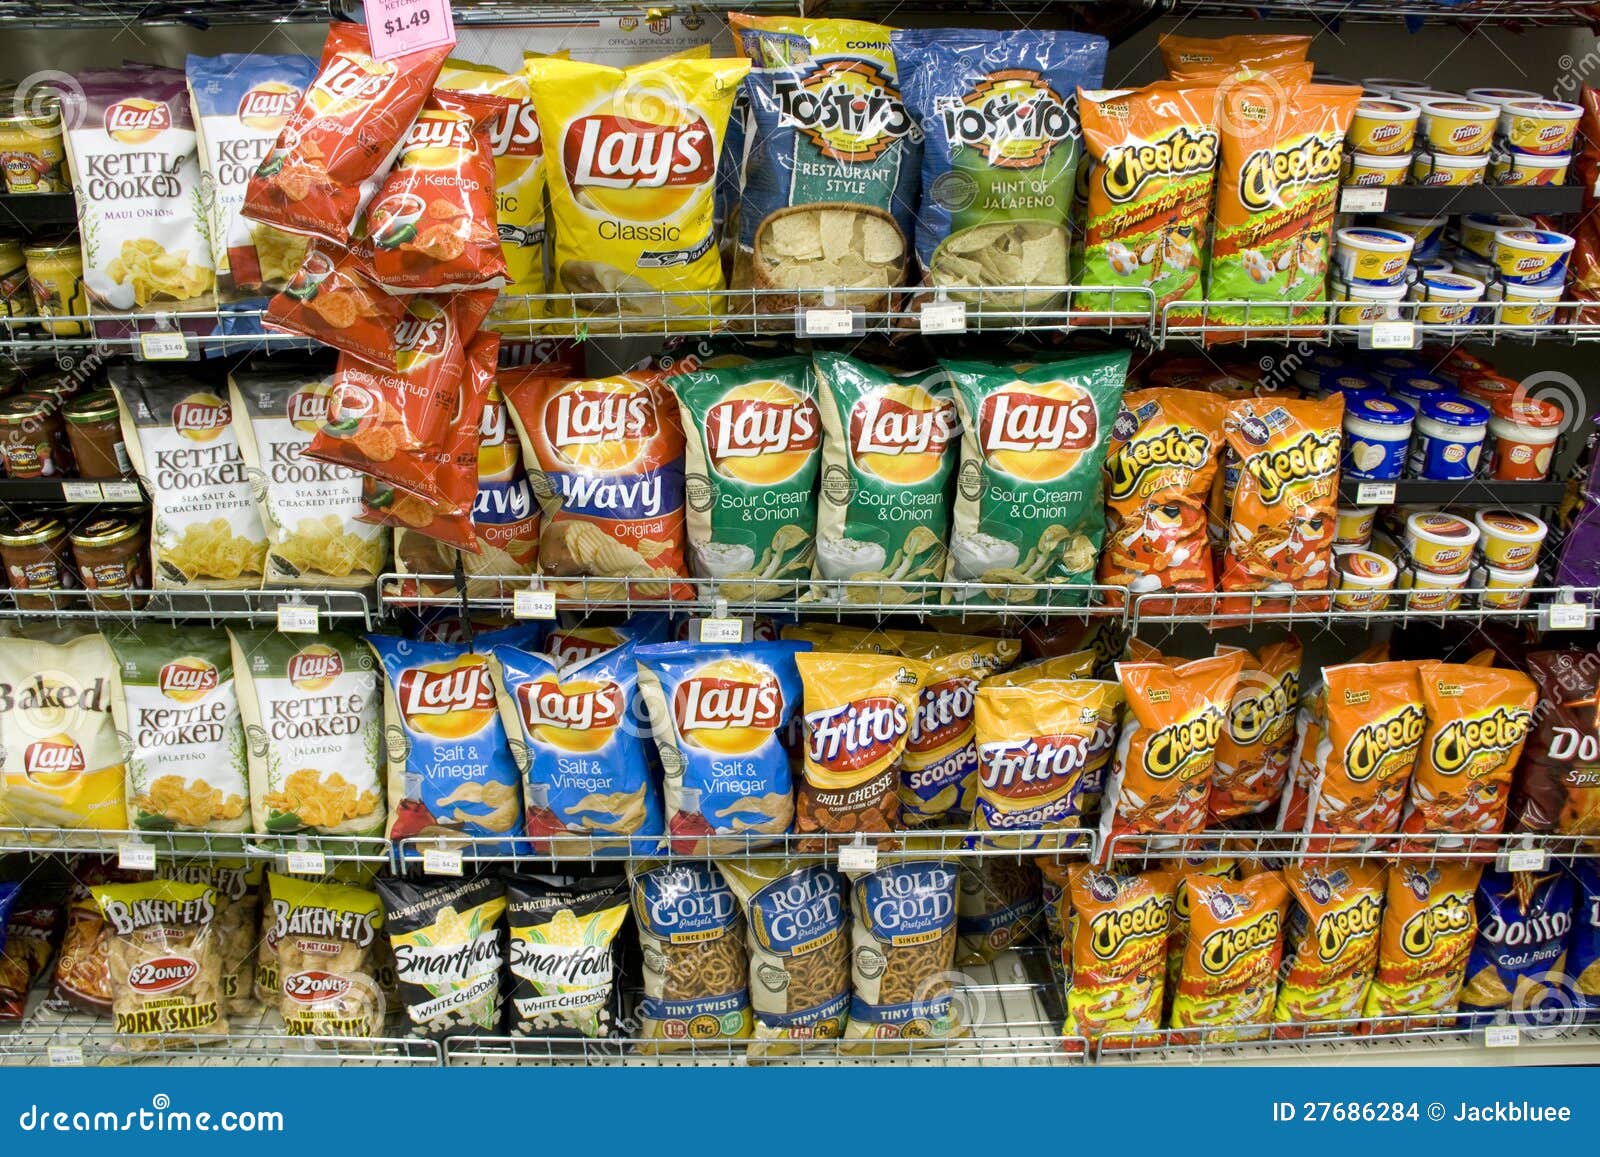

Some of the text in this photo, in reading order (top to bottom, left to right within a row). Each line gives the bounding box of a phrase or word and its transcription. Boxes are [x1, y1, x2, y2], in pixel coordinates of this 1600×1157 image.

[384, 9, 430, 37] $1.49
[608, 38, 636, 46] OFFICIAL
[639, 38, 674, 46] SPONSORS
[846, 40, 892, 50] COMIN
[242, 92, 299, 117] Lay's
[772, 79, 926, 145] Tostitos
[111, 104, 167, 132] Lay's
[935, 90, 1083, 146] Tostitos
[1373, 126, 1402, 141] Fritos
[1453, 125, 1482, 141] Fritos
[1539, 126, 1567, 140] Fritos
[574, 118, 707, 190] Lay's
[802, 162, 891, 182] RESTAURANT
[1102, 128, 1219, 202] Cheetos
[1239, 135, 1343, 211] Cheetos
[424, 174, 480, 192] Ketchup
[826, 180, 866, 194] STYLE
[991, 180, 1050, 193] HINT OF
[1358, 173, 1386, 185] Fritos
[136, 208, 174, 218] ONION
[1157, 195, 1181, 214] Hot
[597, 220, 682, 242] Classic
[1517, 258, 1546, 271] Fritos
[348, 368, 430, 398] Spicy Ketchup
[179, 403, 231, 427] Lay's
[555, 391, 650, 447] Lay's
[988, 396, 1093, 451] Lay's
[715, 402, 815, 459] Lay's
[857, 397, 957, 454] Lay's
[1104, 427, 1209, 499] Cheetos
[1248, 433, 1341, 504] Cheetos
[181, 491, 236, 503] SEA SALT &
[295, 486, 350, 497] SEA SALT &
[472, 479, 531, 519] avy
[561, 474, 662, 516] Wavy
[720, 489, 810, 509] Sour Cream
[858, 490, 944, 506] Sour Cream
[990, 486, 1083, 503] Sour Cream
[164, 499, 251, 513] CRACKED PEPPER
[278, 498, 326, 508] CRACKED
[878, 505, 933, 521] & Onion
[1009, 504, 1067, 519] & Onion
[742, 505, 800, 522] & Onion
[485, 521, 532, 541] Original
[614, 521, 664, 537] Original
[1434, 548, 1463, 562] Fritos
[1507, 545, 1533, 559] Fritos
[534, 602, 553, 611] $4.29
[720, 629, 739, 637] $4.29
[291, 654, 343, 680] Lay's
[164, 665, 218, 693] Lay's
[405, 665, 494, 716] Lay's
[529, 683, 616, 730] Lay's
[682, 678, 781, 732] Lay's
[804, 699, 910, 761] Fritos
[926, 726, 960, 745] BRAND
[1432, 706, 1532, 775] Cheetos
[28, 744, 85, 774] Lay's
[433, 746, 480, 762] Salt &
[842, 750, 878, 766] BRAND
[978, 735, 1091, 789] Fritos
[425, 762, 489, 782] Vinegar
[557, 759, 602, 775] Salt &
[711, 762, 756, 777] Salt &
[550, 773, 613, 794] Vinegar
[703, 775, 767, 795] Vinegar
[816, 771, 894, 804] CHILI CHEESE
[1016, 782, 1054, 794] BRAND
[989, 794, 1073, 829] SCOOPS!
[769, 872, 836, 908] ROLD
[878, 869, 951, 900] ROLD
[387, 877, 491, 921] ALL-NATURAL INGREDIENTS
[508, 896, 561, 913] ALL-NATURAL
[105, 888, 216, 936] BAKEN-ETS
[651, 892, 737, 928] GOLD
[770, 894, 843, 942] GOLD
[873, 892, 955, 929] GOLD
[273, 898, 380, 949] BAKEN-ETS
[678, 916, 713, 929] Pretzels
[797, 921, 827, 938] Pretzels
[900, 918, 932, 930] Pretzels
[1090, 900, 1174, 959] Cheetos
[1483, 909, 1573, 946] Doritos
[676, 930, 719, 944] SINCE 1917
[796, 932, 835, 953] SINCE 1917
[897, 931, 937, 945] SINCE 1917
[391, 935, 501, 979] Smartfood
[509, 938, 613, 983] Smartfood
[1498, 953, 1527, 968] Cool
[128, 964, 194, 986] $2 ONLY
[286, 975, 346, 995] $2 ONLY
[143, 997, 185, 1009] TRADITIONAL
[416, 974, 499, 1019] WHITE CHEDDAR
[522, 988, 609, 1014] WHITE CHEDDAR
[665, 997, 739, 1015] TINY TWISTS
[116, 1001, 218, 1035] PORK SKINS
[790, 1011, 819, 1026] TINY
[880, 1001, 951, 1020] TINY TWISTS
